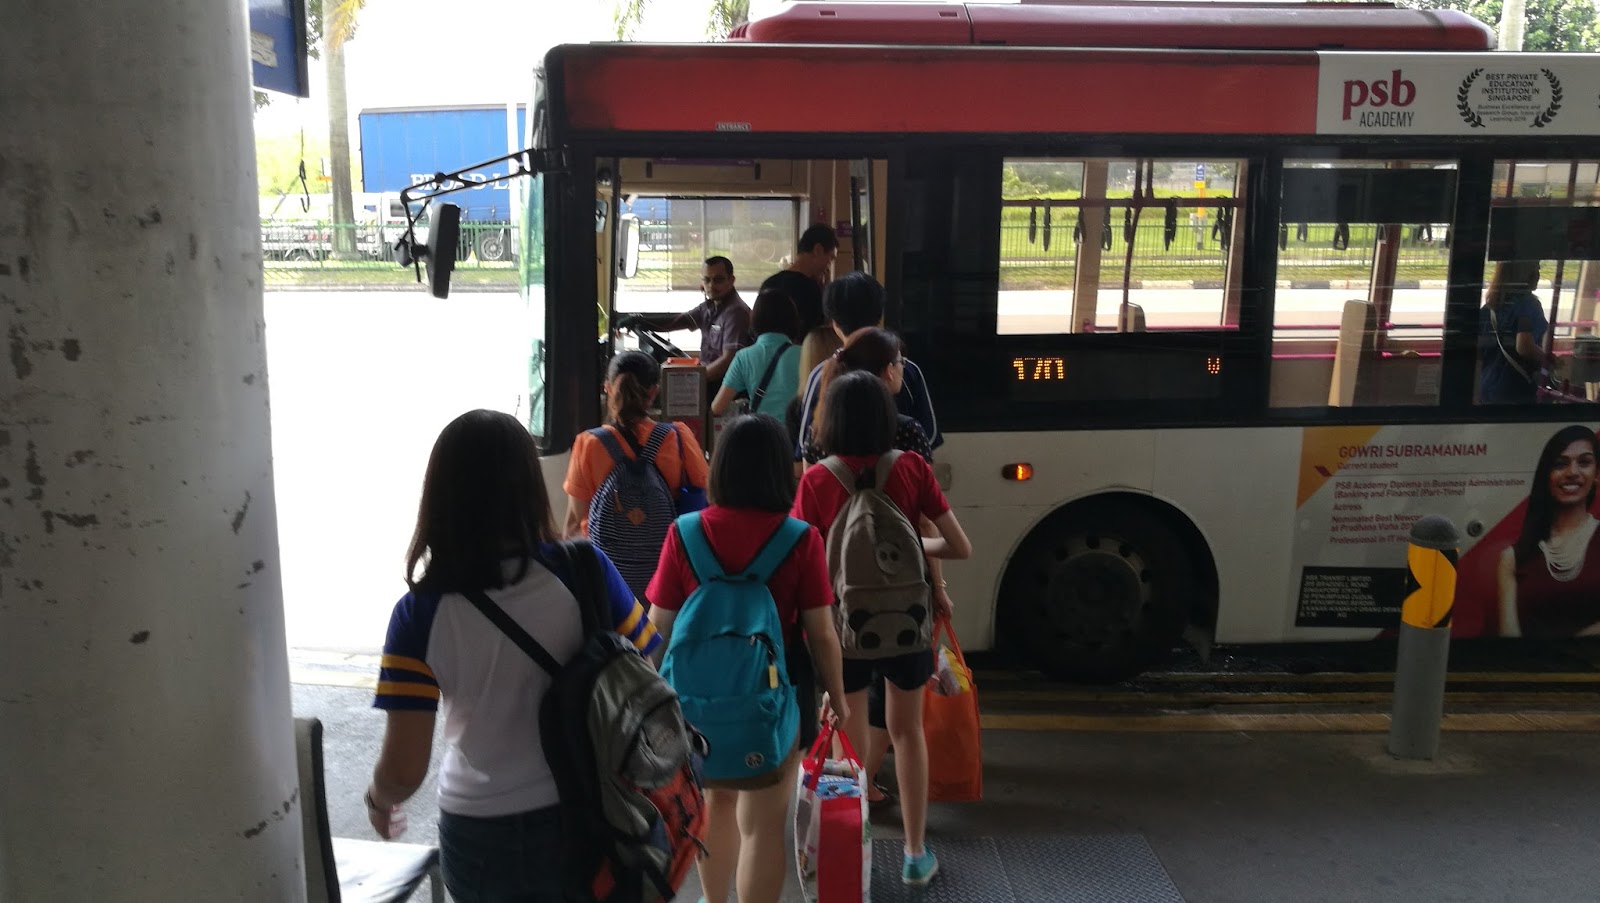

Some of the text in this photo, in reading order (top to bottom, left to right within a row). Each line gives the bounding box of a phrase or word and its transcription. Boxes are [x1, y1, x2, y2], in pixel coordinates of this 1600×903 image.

[1486, 73, 1538, 81] BEST PRIVATE
[1489, 80, 1534, 88] EDUCATION
[1343, 69, 1417, 121] psb
[1481, 87, 1540, 95] INSTITUTION IN
[1488, 94, 1533, 102] SINGAPORE
[1359, 111, 1415, 128] ACADEMY
[1339, 444, 1488, 458] GOWRI SUBRAMANIAM
[1368, 461, 1399, 469] student
[1335, 481, 1352, 489] PSB
[1353, 481, 1388, 491] Academy
[1468, 479, 1526, 487] Administration
